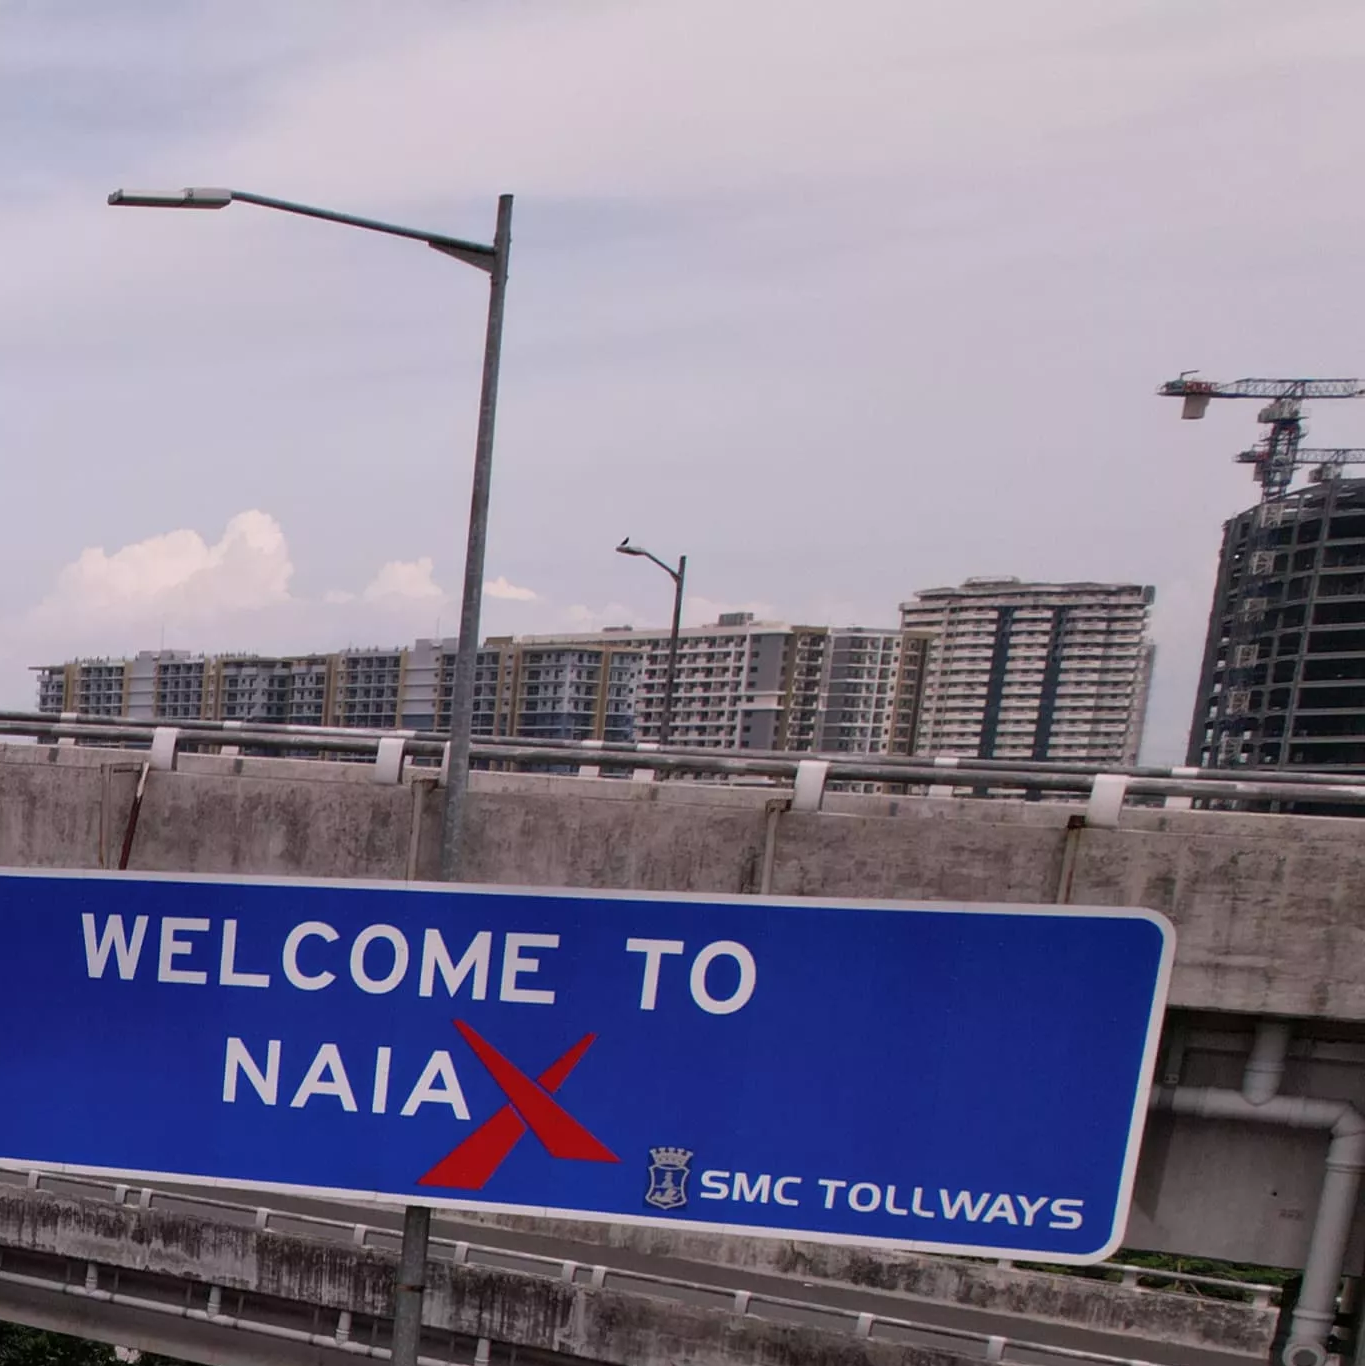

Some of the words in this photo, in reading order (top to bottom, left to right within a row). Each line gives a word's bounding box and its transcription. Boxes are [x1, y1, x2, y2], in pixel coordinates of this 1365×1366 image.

[80, 912, 561, 1005] WELCOME
[625, 937, 758, 1016] TO
[700, 1169, 802, 1206] SMC
[818, 1179, 1084, 1230] TOLLWAYS
